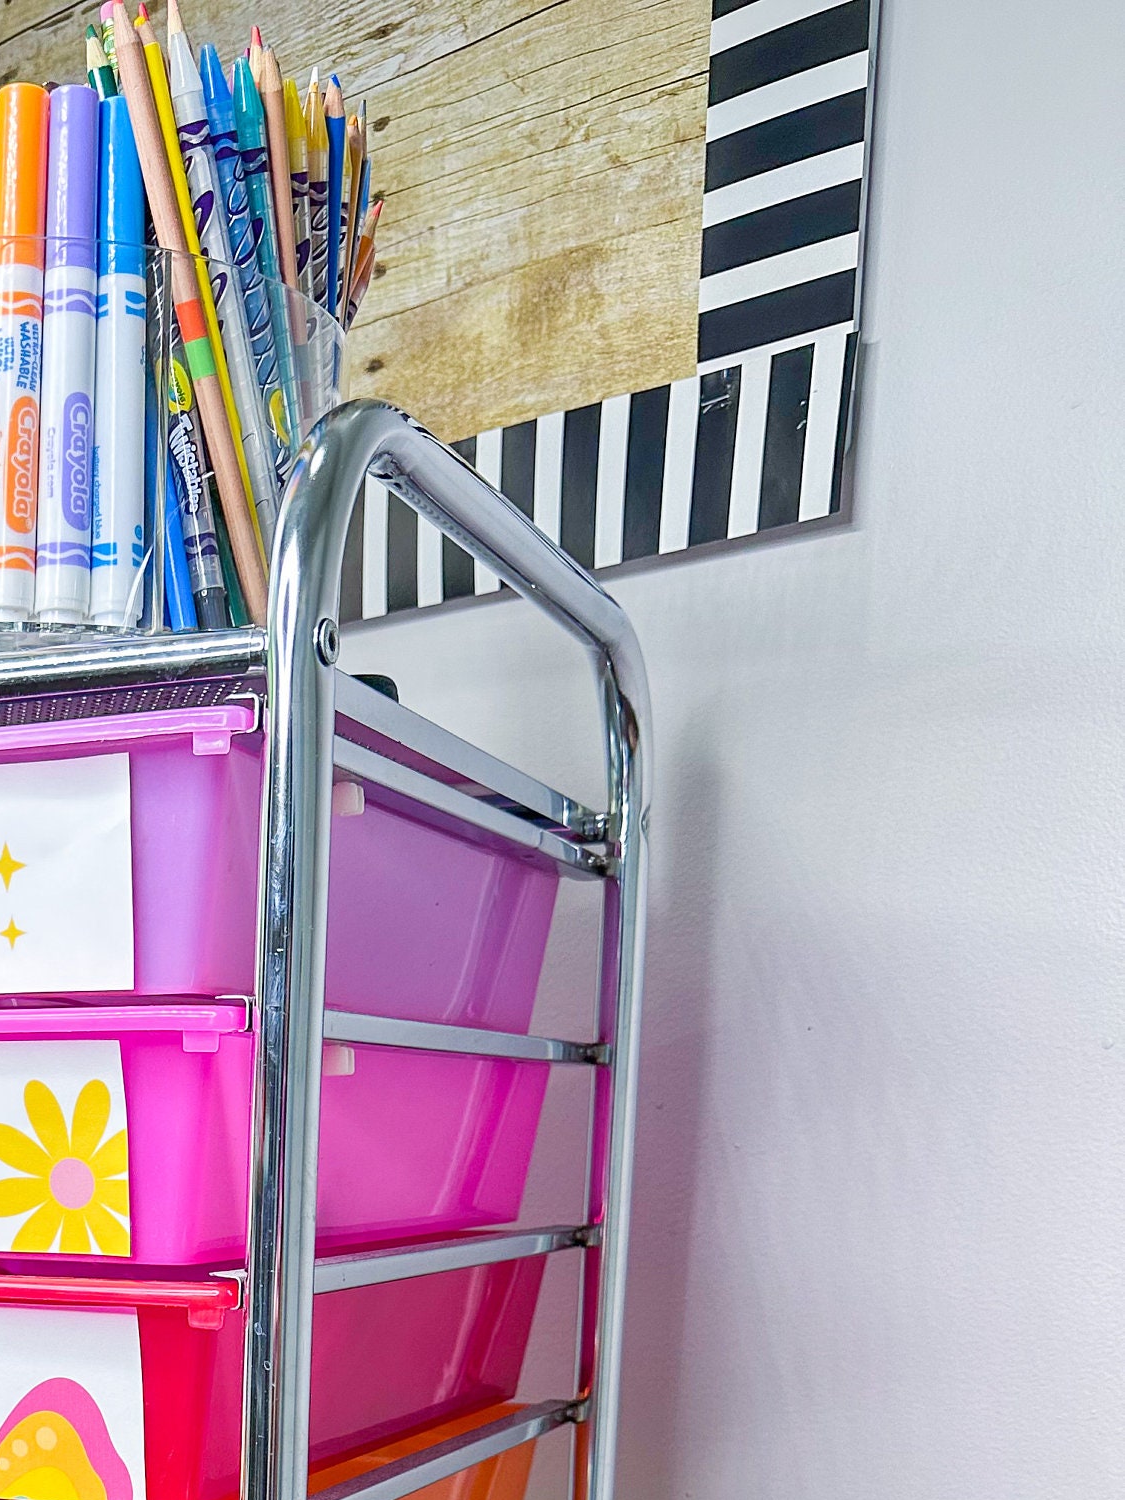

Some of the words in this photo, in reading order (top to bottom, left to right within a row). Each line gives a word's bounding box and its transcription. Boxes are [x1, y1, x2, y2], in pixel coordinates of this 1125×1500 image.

[3, 337, 15, 372] ULTRA
[16, 321, 32, 389] WASHABLE
[29, 323, 39, 393] ULTRA-CLEAN
[11, 407, 36, 518] Crayola
[65, 402, 90, 514] Crayola
[168, 413, 202, 514] Twistables
